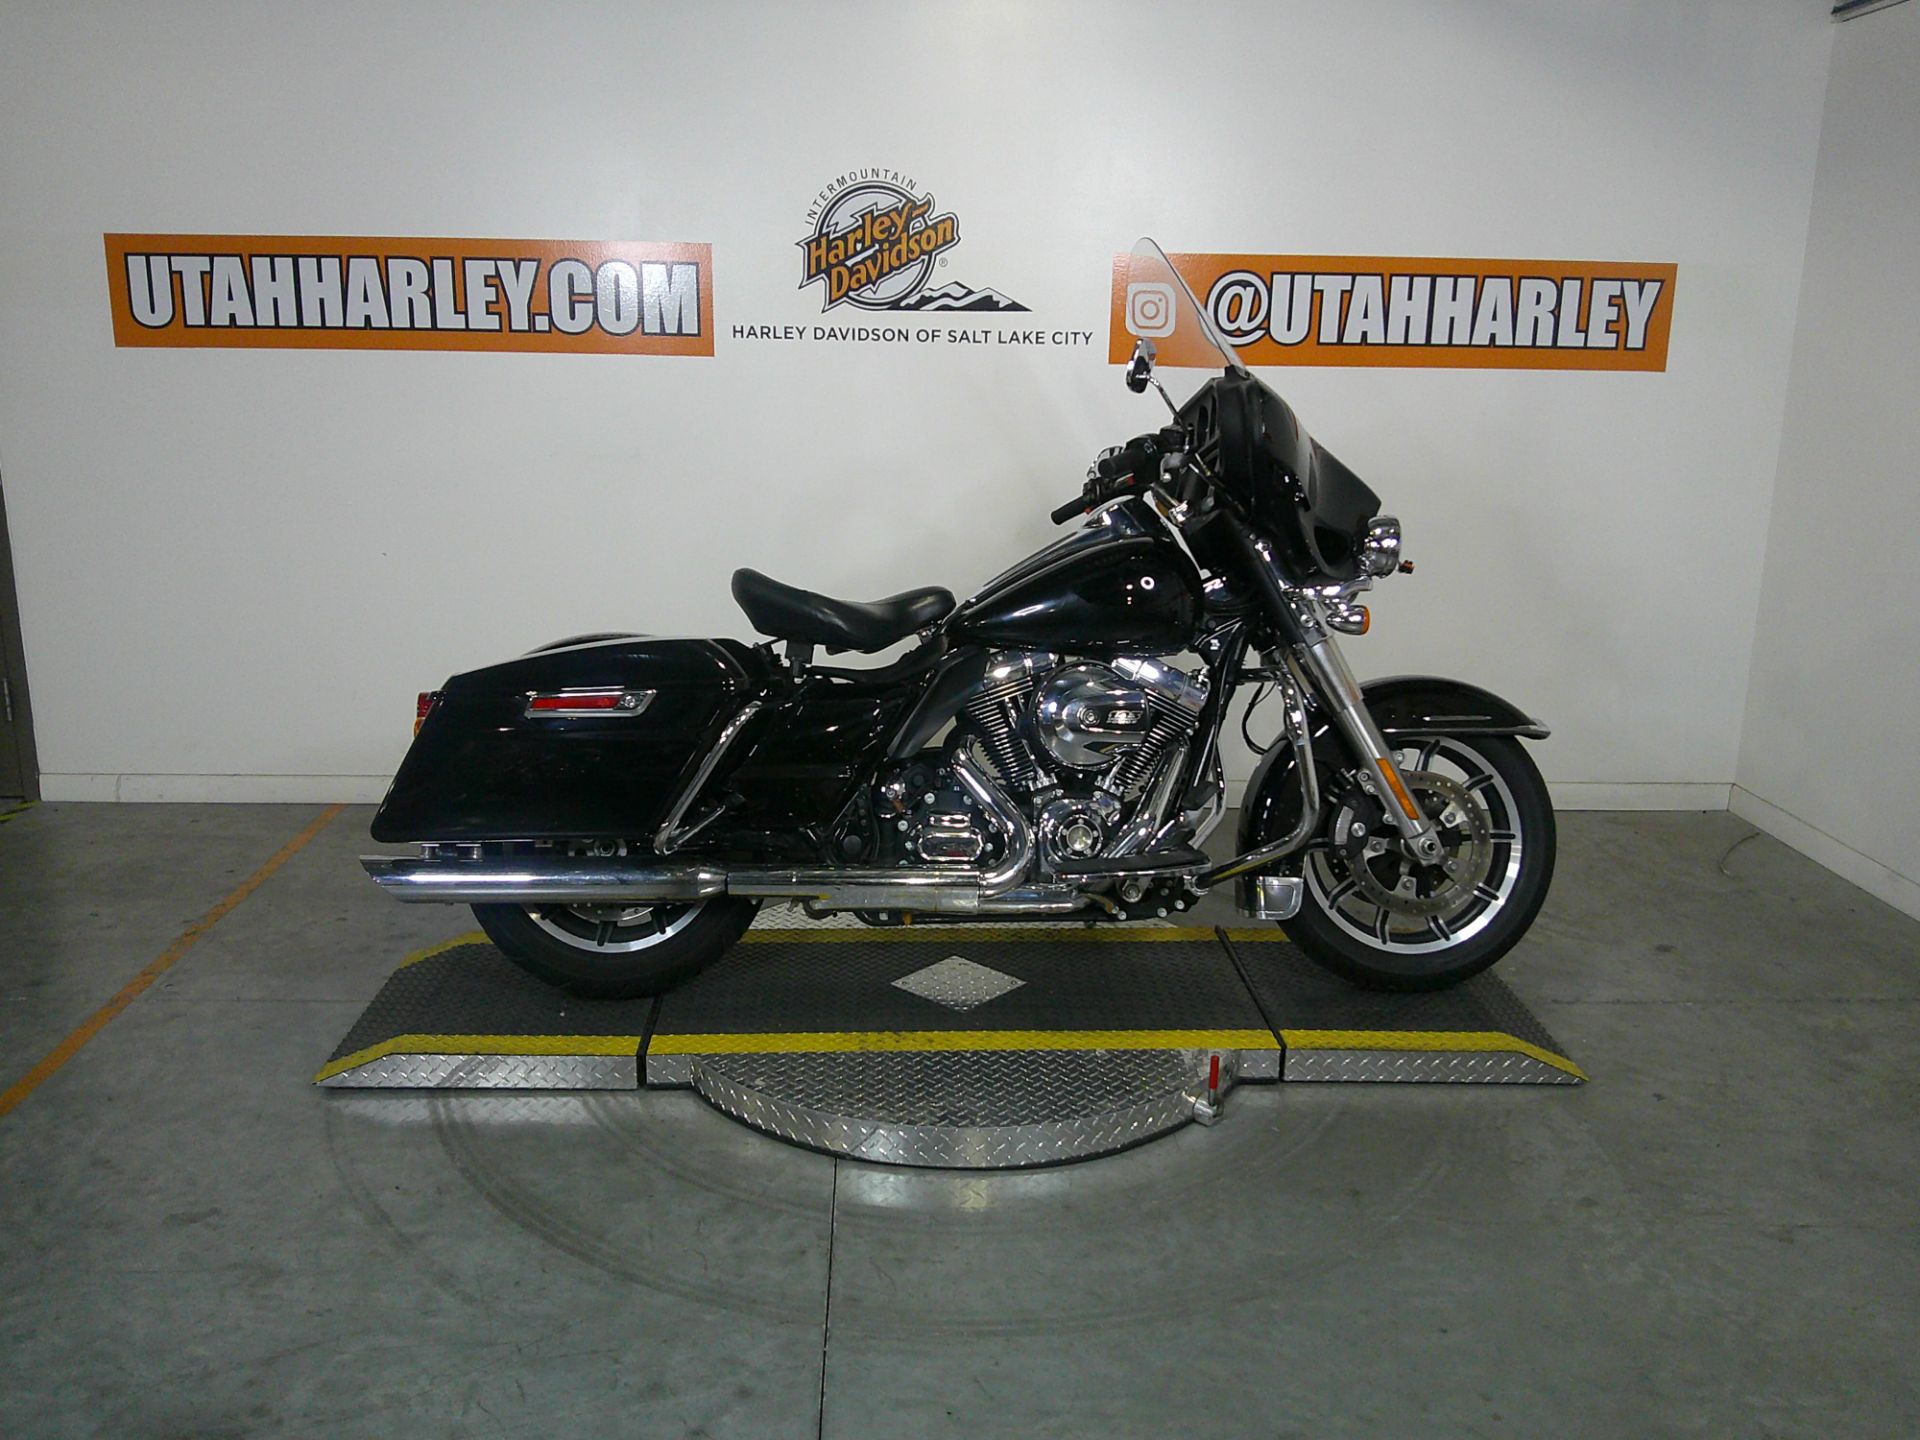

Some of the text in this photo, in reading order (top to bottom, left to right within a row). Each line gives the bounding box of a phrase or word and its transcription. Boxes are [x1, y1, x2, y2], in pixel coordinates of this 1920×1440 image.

[805, 168, 917, 226] INTERMOUNTAIN
[124, 252, 701, 337] UTAHHARLEY.COM
[830, 218, 954, 301] Davidson
[732, 325, 1093, 346] HARLEY DAVIDSON OF SALT LAKE CITY
[1206, 269, 1664, 351] @UTAHHARLEY
